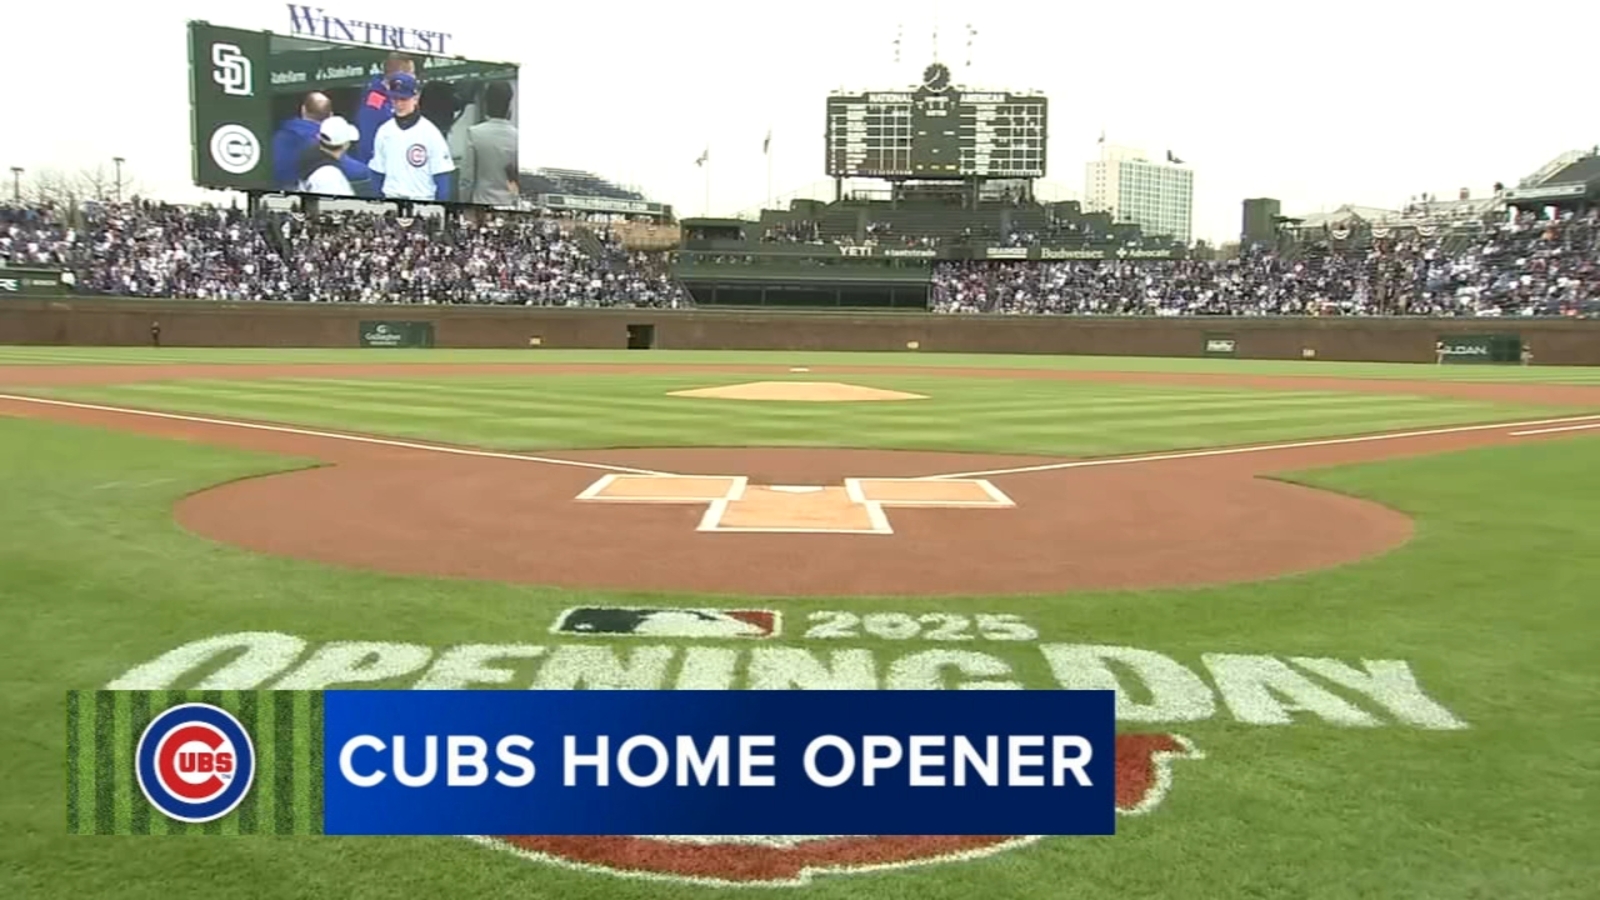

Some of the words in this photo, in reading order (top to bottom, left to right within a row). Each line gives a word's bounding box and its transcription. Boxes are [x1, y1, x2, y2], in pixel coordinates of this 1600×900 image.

[287, 4, 452, 54] WINTRUST
[840, 246, 872, 256] YETI
[1041, 247, 1104, 259] Budweiser
[805, 611, 1038, 641] 2025
[1039, 643, 1470, 730] DAY
